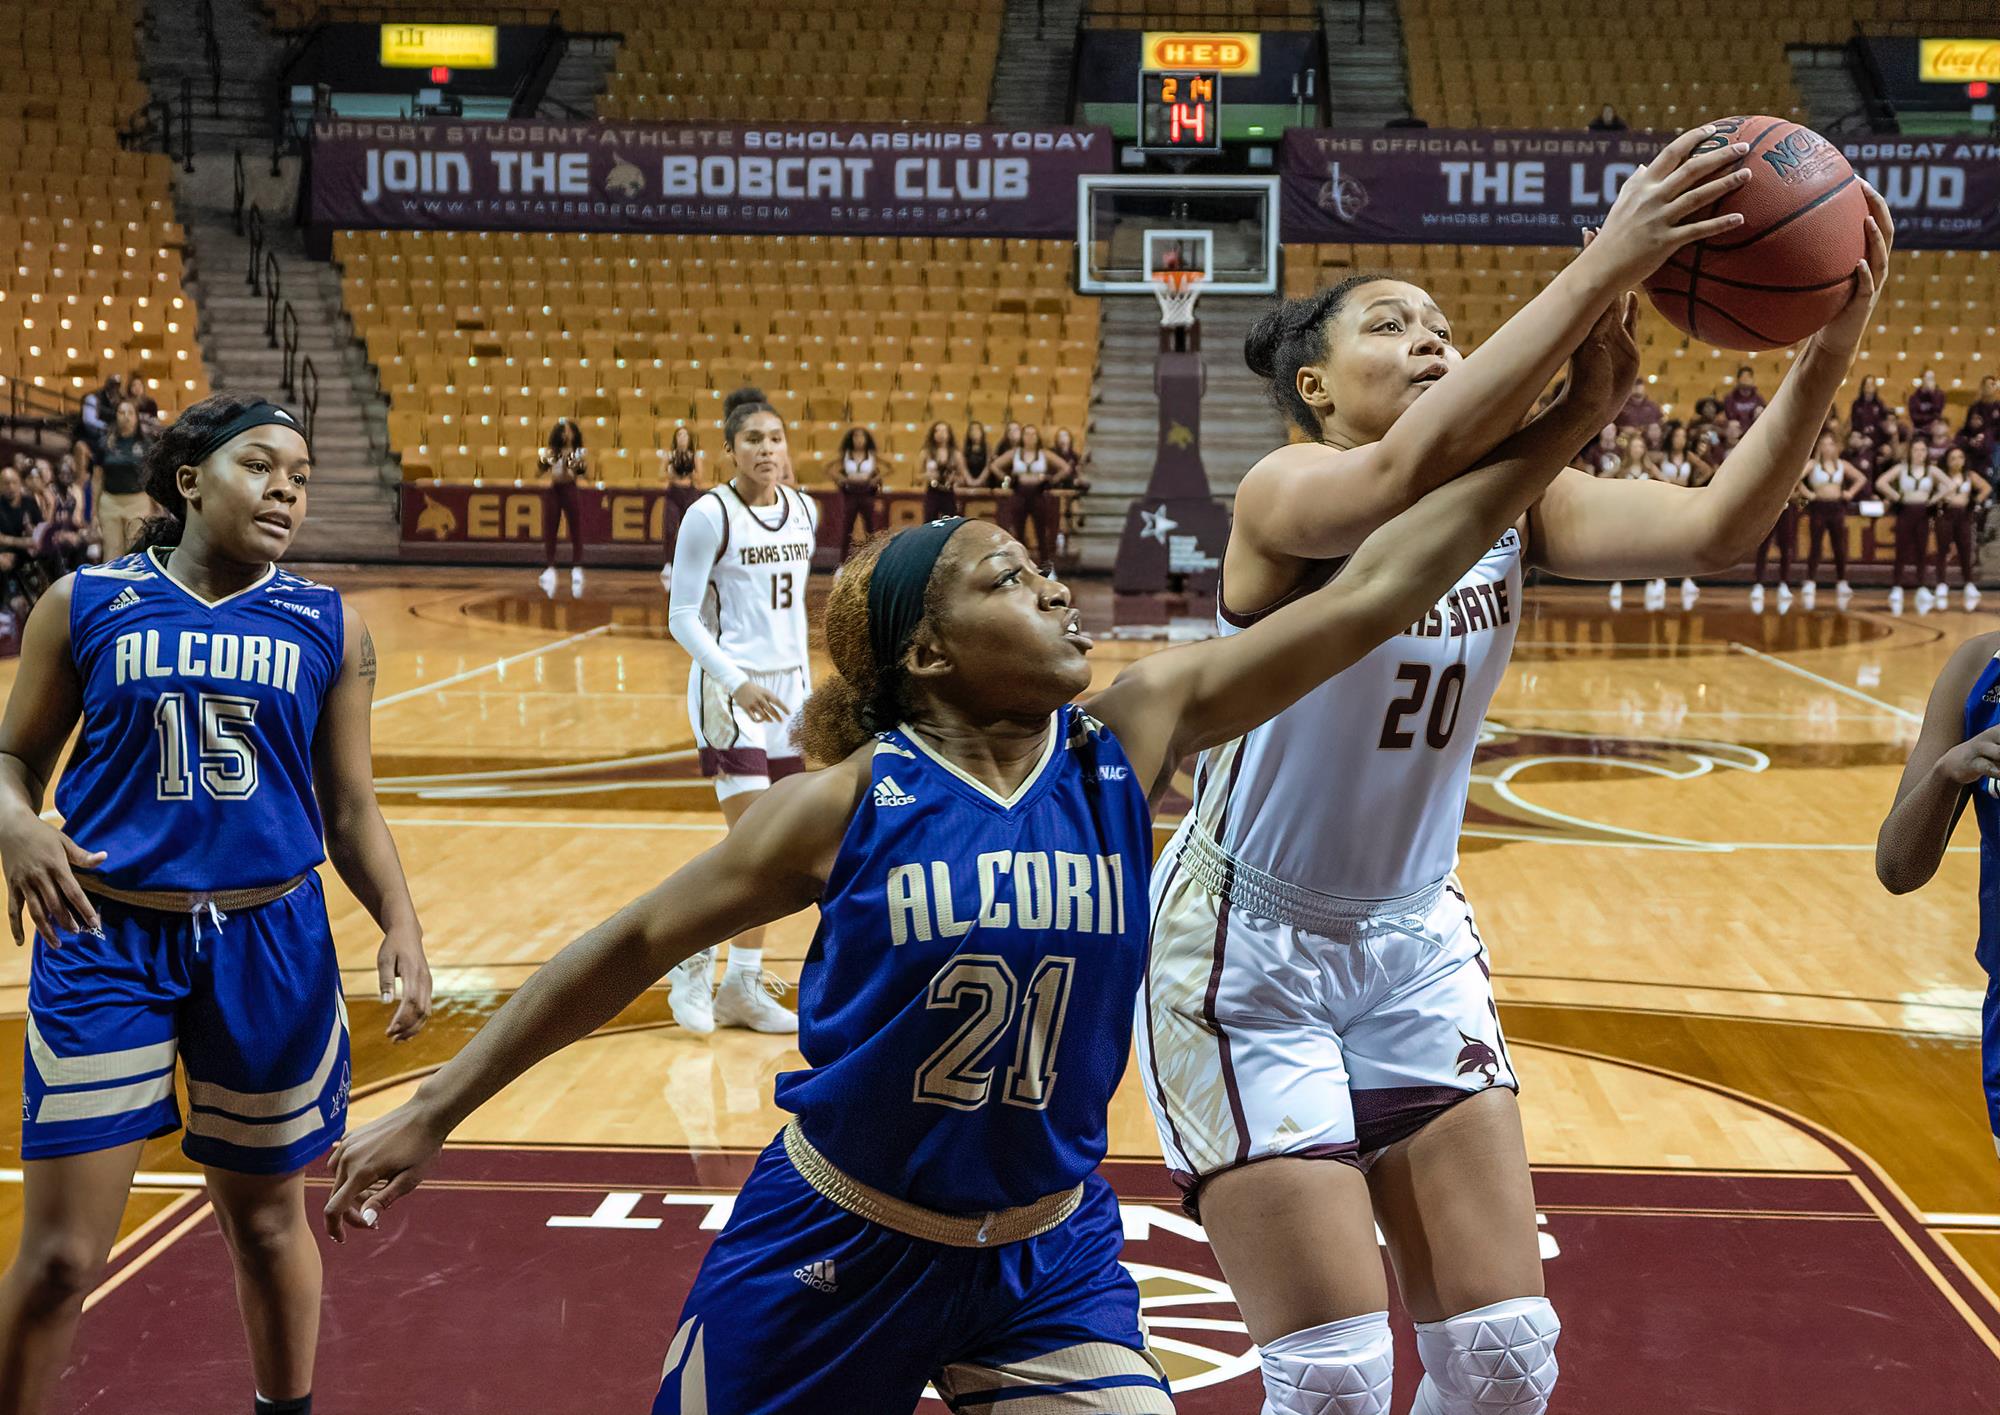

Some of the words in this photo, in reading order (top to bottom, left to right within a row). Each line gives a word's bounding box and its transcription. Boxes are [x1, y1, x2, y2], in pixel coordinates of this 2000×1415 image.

[447, 126, 733, 146] STUDENT-ATHLETE
[744, 131, 982, 149] SCHOLARSHIPS
[992, 132, 1095, 149] TODAY
[1170, 103, 1205, 143] 14
[1315, 137, 1362, 152] THE
[1372, 138, 1485, 153] OFFICIAL
[1498, 139, 1611, 154] STUDENT
[1842, 143, 1945, 159] BOBCAT
[361, 149, 471, 204] JOIN
[491, 151, 590, 195] THE
[662, 154, 874, 198] BOBCAT
[895, 156, 1029, 199] CLUB
[1440, 161, 1545, 204] THE
[1422, 213, 1490, 225] WHOSE
[740, 545, 781, 565] TEXAS
[782, 543, 809, 561] STATE
[283, 602, 320, 619] SWAC
[771, 572, 792, 610] 13
[115, 629, 301, 694] ALCORN
[1377, 663, 1467, 750] 20
[154, 692, 260, 801] 15
[887, 850, 1126, 946] ALCORN
[913, 954, 1076, 1111] 21
[793, 1268, 839, 1293] adidas
